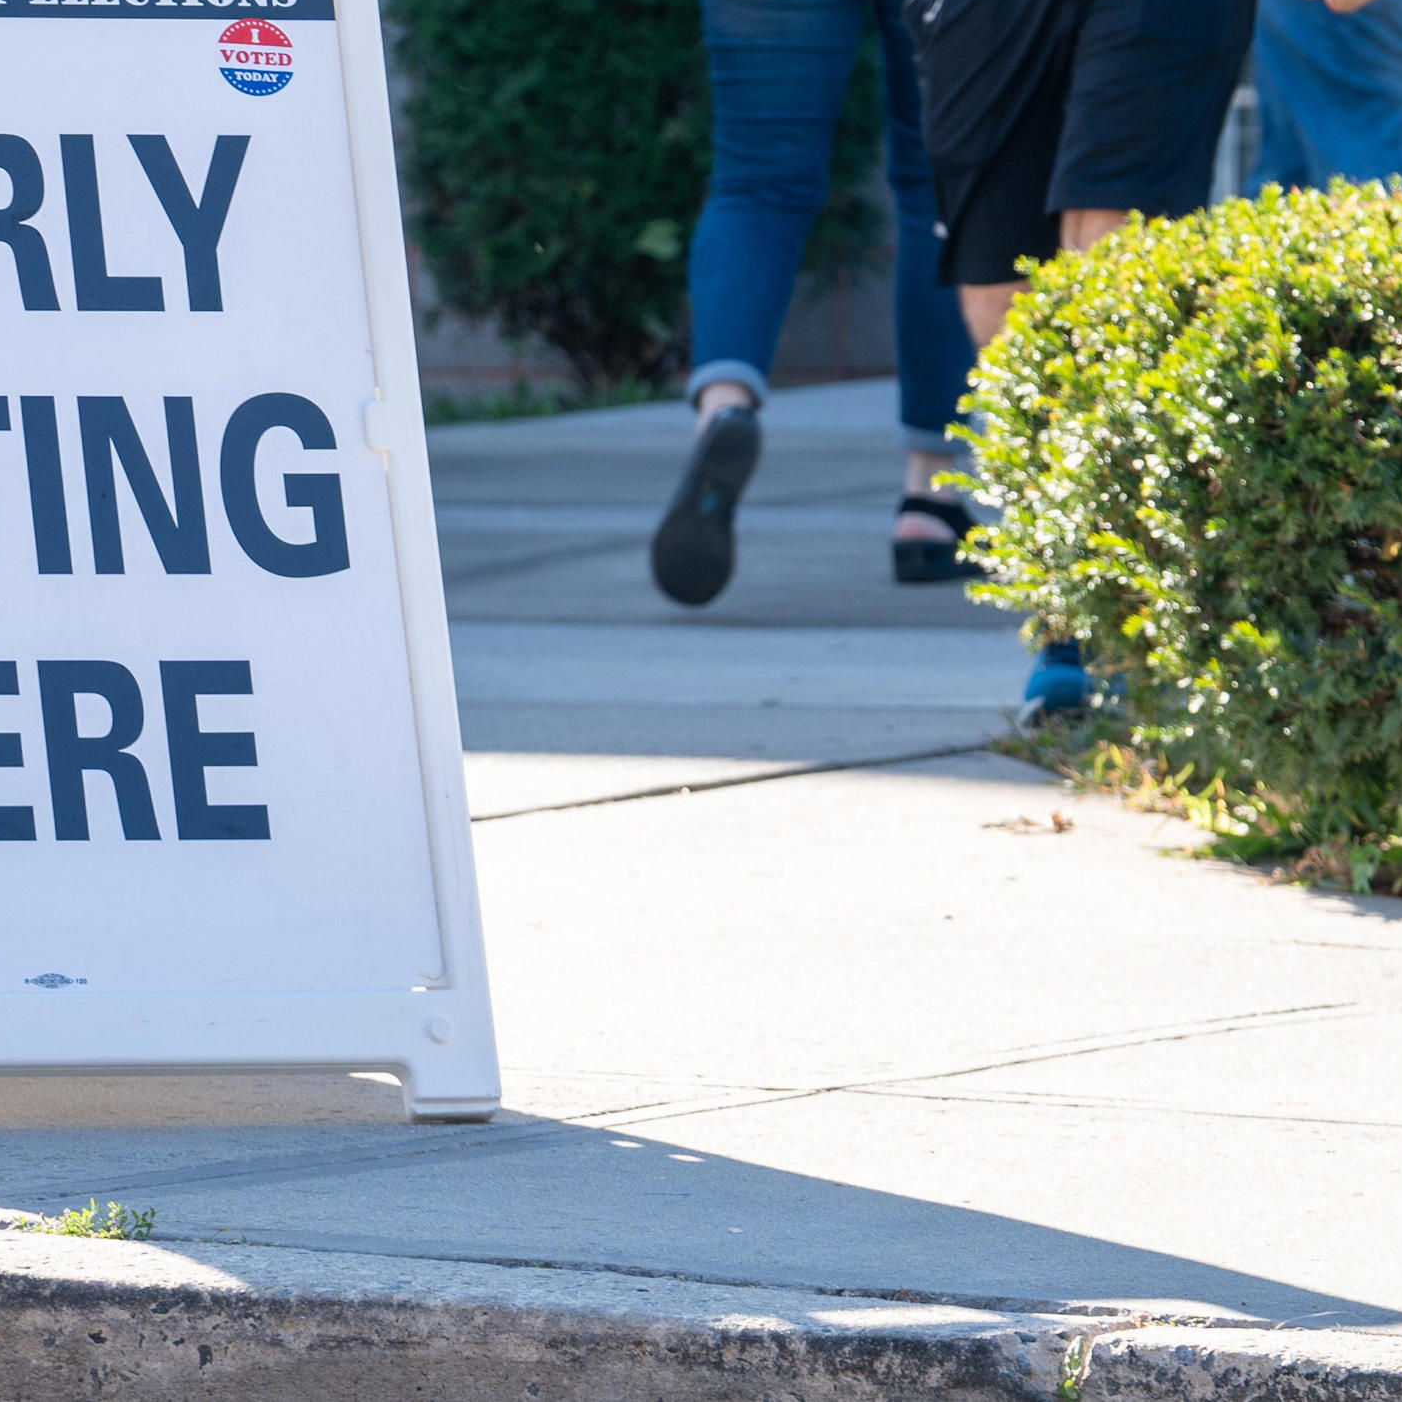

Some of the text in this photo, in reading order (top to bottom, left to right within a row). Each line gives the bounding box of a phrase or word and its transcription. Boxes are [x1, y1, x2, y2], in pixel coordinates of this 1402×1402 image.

[250, 28, 260, 43] I
[220, 49, 292, 66] VOTED
[234, 71, 279, 83] TODAY
